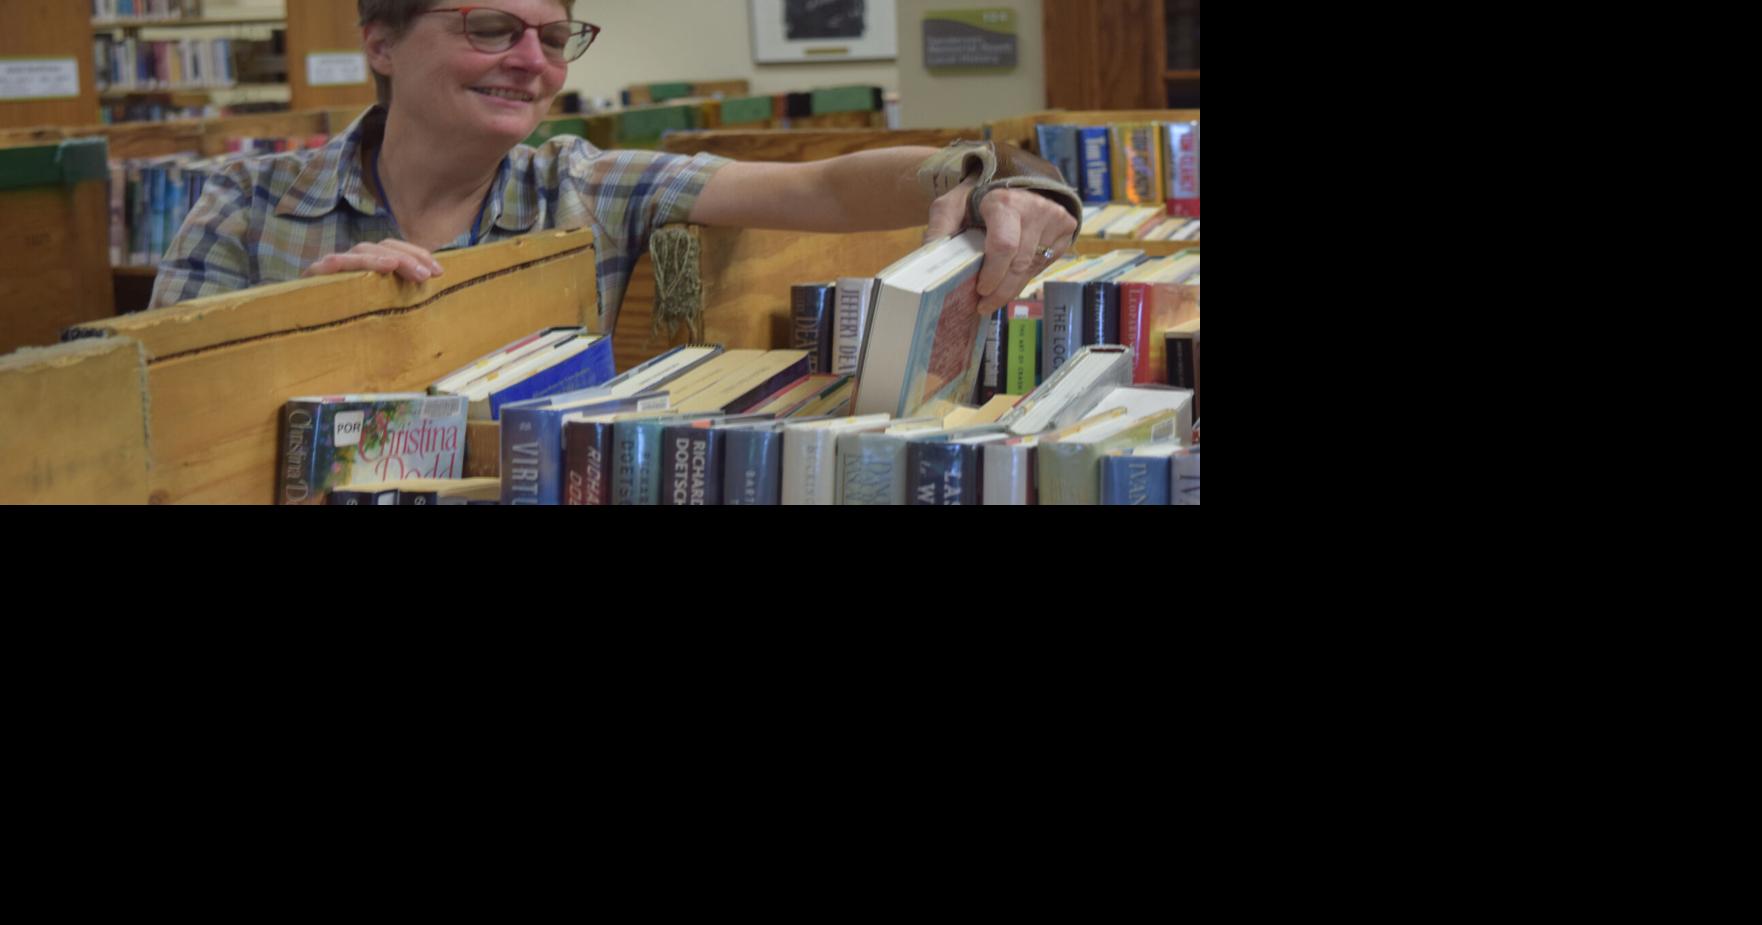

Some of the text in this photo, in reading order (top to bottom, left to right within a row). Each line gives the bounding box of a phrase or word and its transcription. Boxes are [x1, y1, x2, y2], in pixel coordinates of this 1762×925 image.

[839, 288, 859, 338] JEFFERY
[1052, 304, 1066, 370] THE LOC
[287, 408, 313, 479] Christina
[337, 423, 361, 434] POR
[358, 415, 459, 464] Christina
